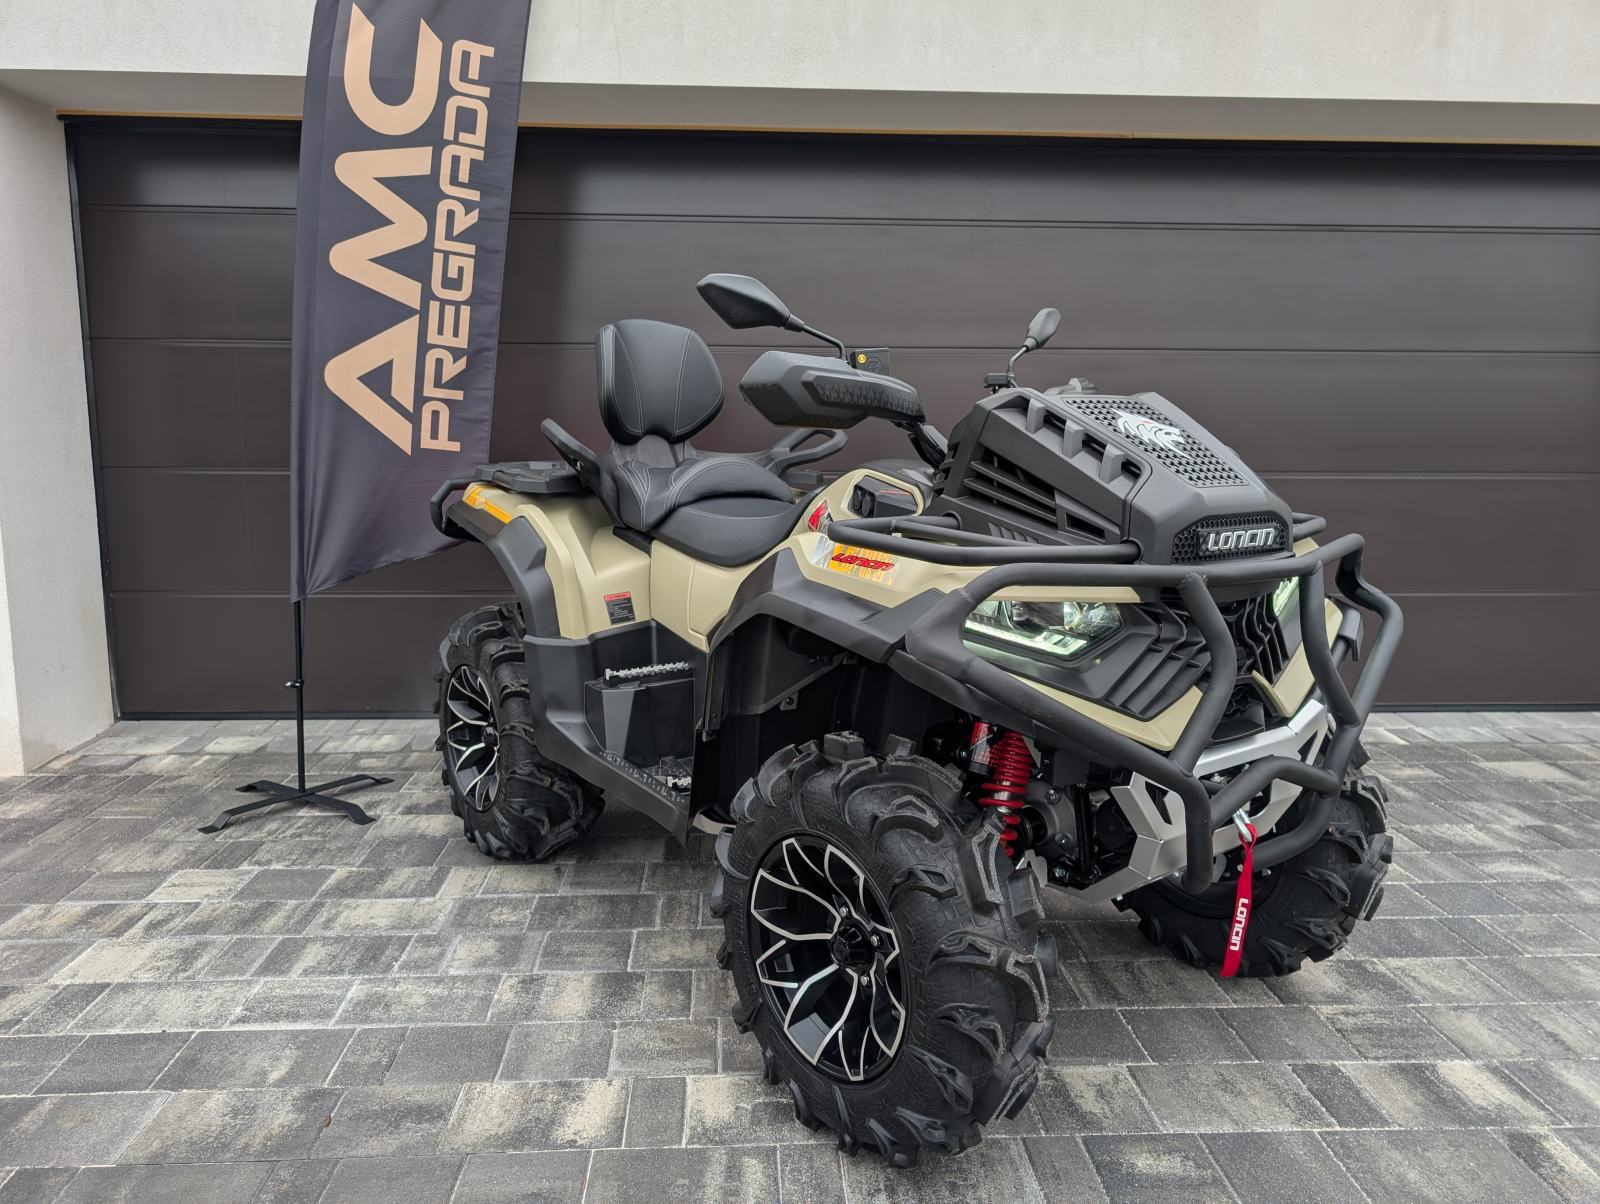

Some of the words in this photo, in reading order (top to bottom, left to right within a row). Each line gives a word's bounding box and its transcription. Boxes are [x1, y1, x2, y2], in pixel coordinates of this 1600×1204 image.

[324, 2, 443, 456] AMC
[420, 39, 495, 452] PREGRADA
[1207, 528, 1275, 551] LONCIN
[1230, 898, 1249, 951] LONCIN
